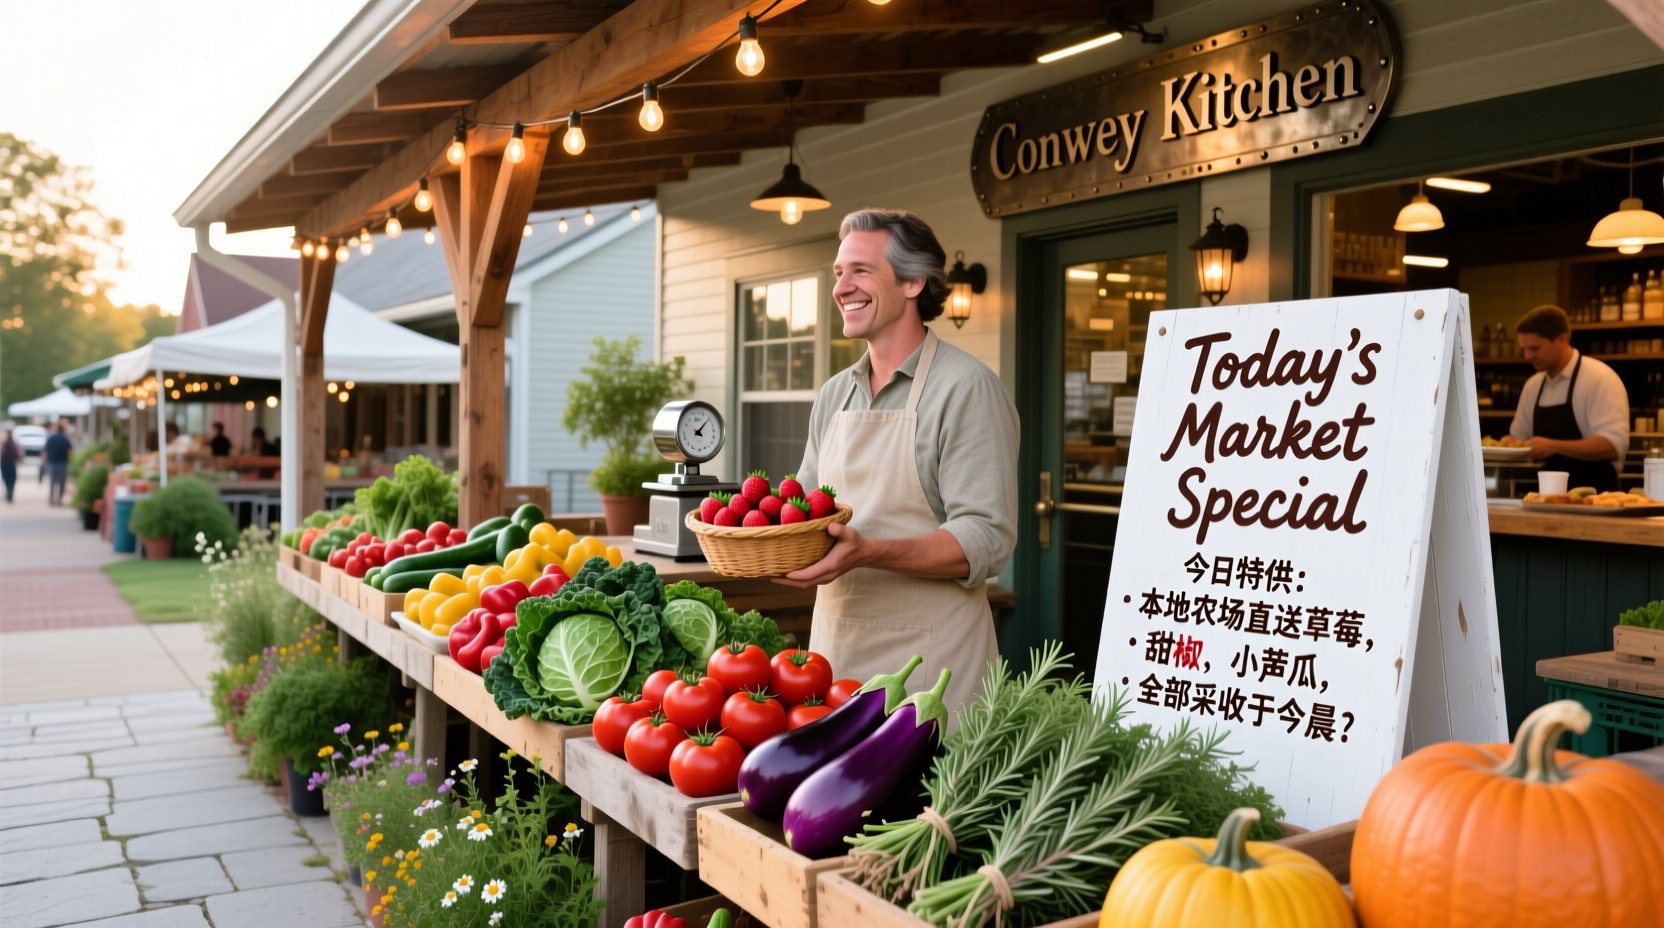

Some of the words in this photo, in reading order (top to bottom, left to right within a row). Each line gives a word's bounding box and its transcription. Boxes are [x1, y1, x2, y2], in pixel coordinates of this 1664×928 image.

[989, 109, 1147, 181] Conwey
[1160, 52, 1361, 142] Kitchen
[1185, 328, 1382, 407] Today's
[1160, 399, 1376, 464] Market
[1168, 467, 1368, 546] Special
[1184, 552, 1306, 594] 今日特供：
